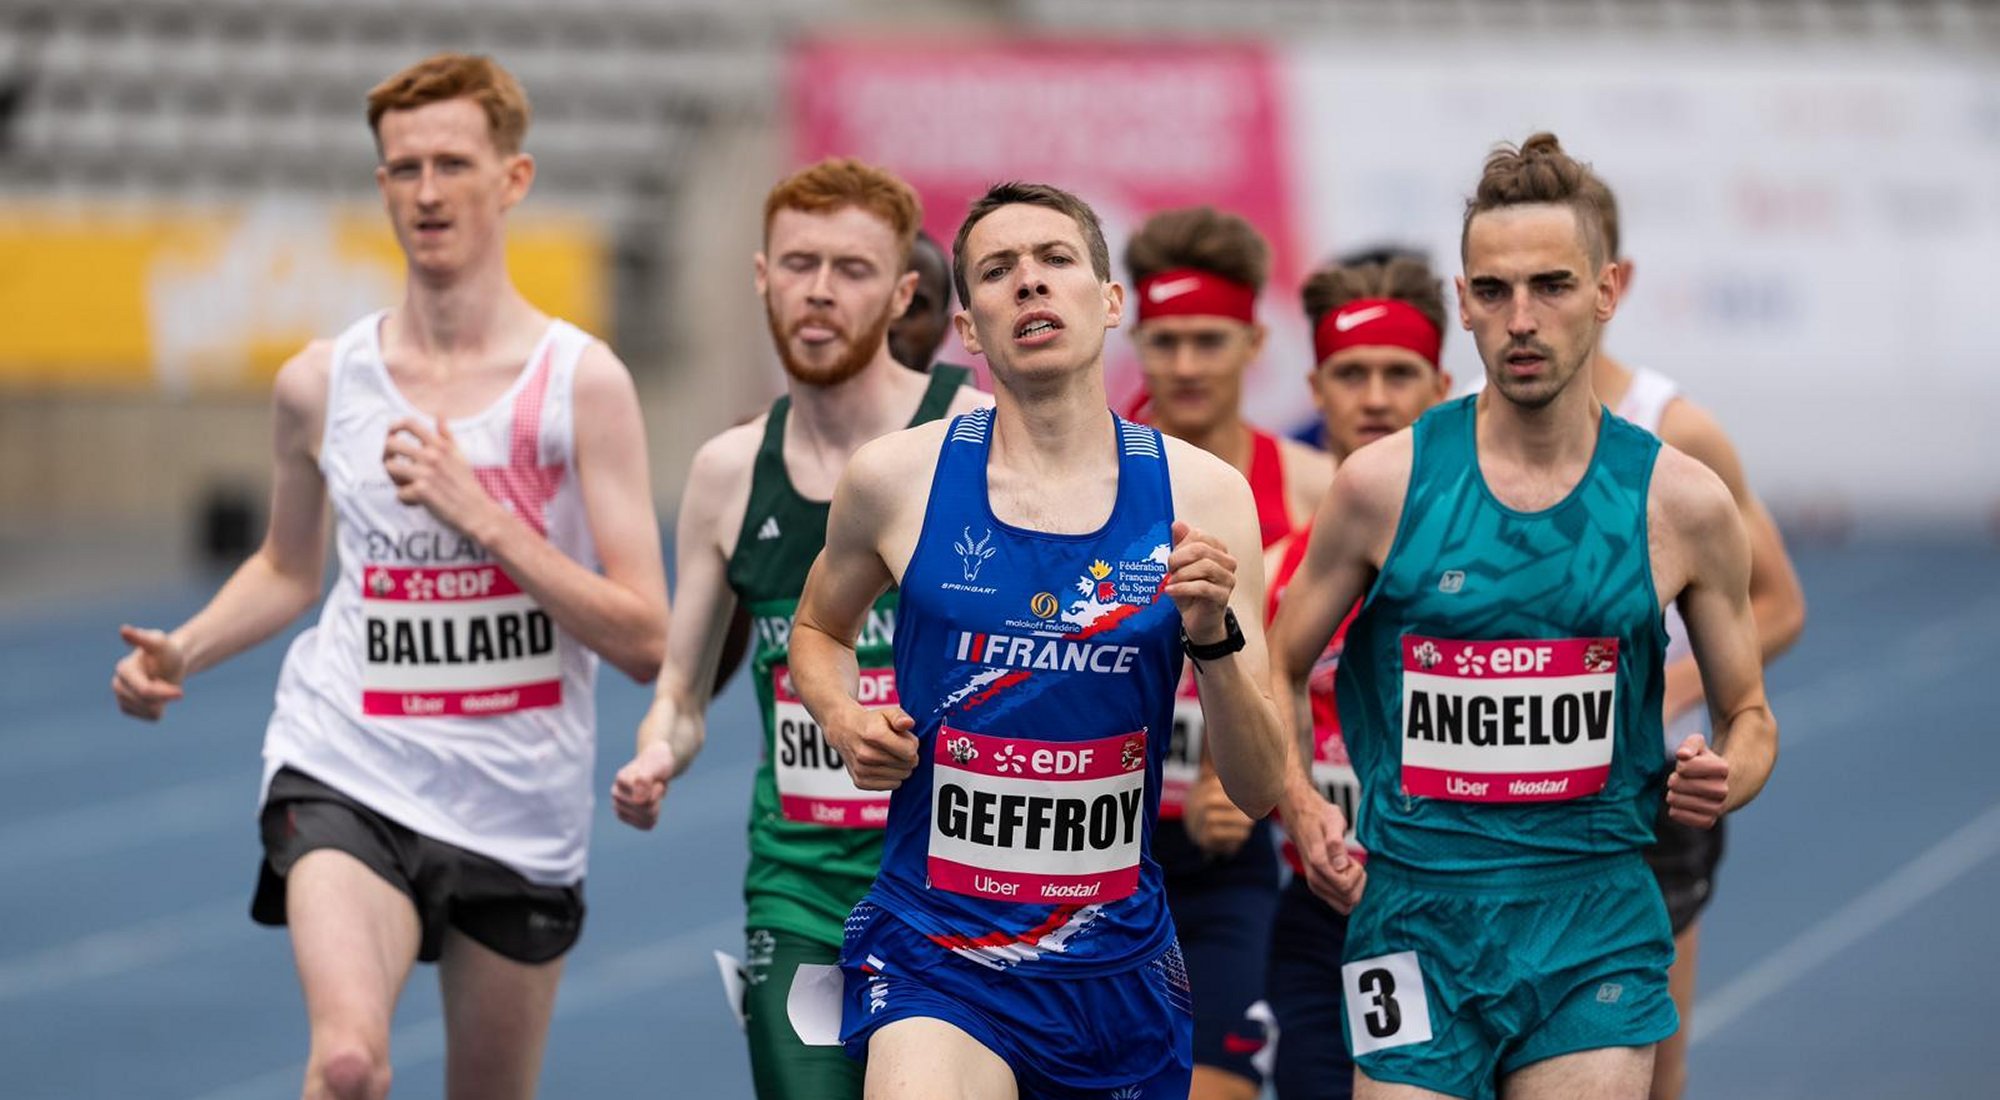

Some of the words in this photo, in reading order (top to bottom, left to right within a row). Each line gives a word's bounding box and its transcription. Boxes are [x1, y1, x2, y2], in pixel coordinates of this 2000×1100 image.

[1119, 561, 1165, 572] Fédération
[1119, 572, 1161, 583] Française
[1119, 582, 1131, 592] du
[1132, 583, 1157, 595] Sport
[1119, 593, 1151, 605] Adapté
[367, 608, 554, 665] BALLARD
[1045, 621, 1081, 633] médéric
[983, 636, 1140, 673] FRANCE
[1407, 689, 1613, 746] ANGELOV
[1446, 776, 1489, 796] Uber
[937, 783, 1142, 851] GEFFROY
[974, 875, 1020, 896] Uber
[1358, 967, 1402, 1038] 3
